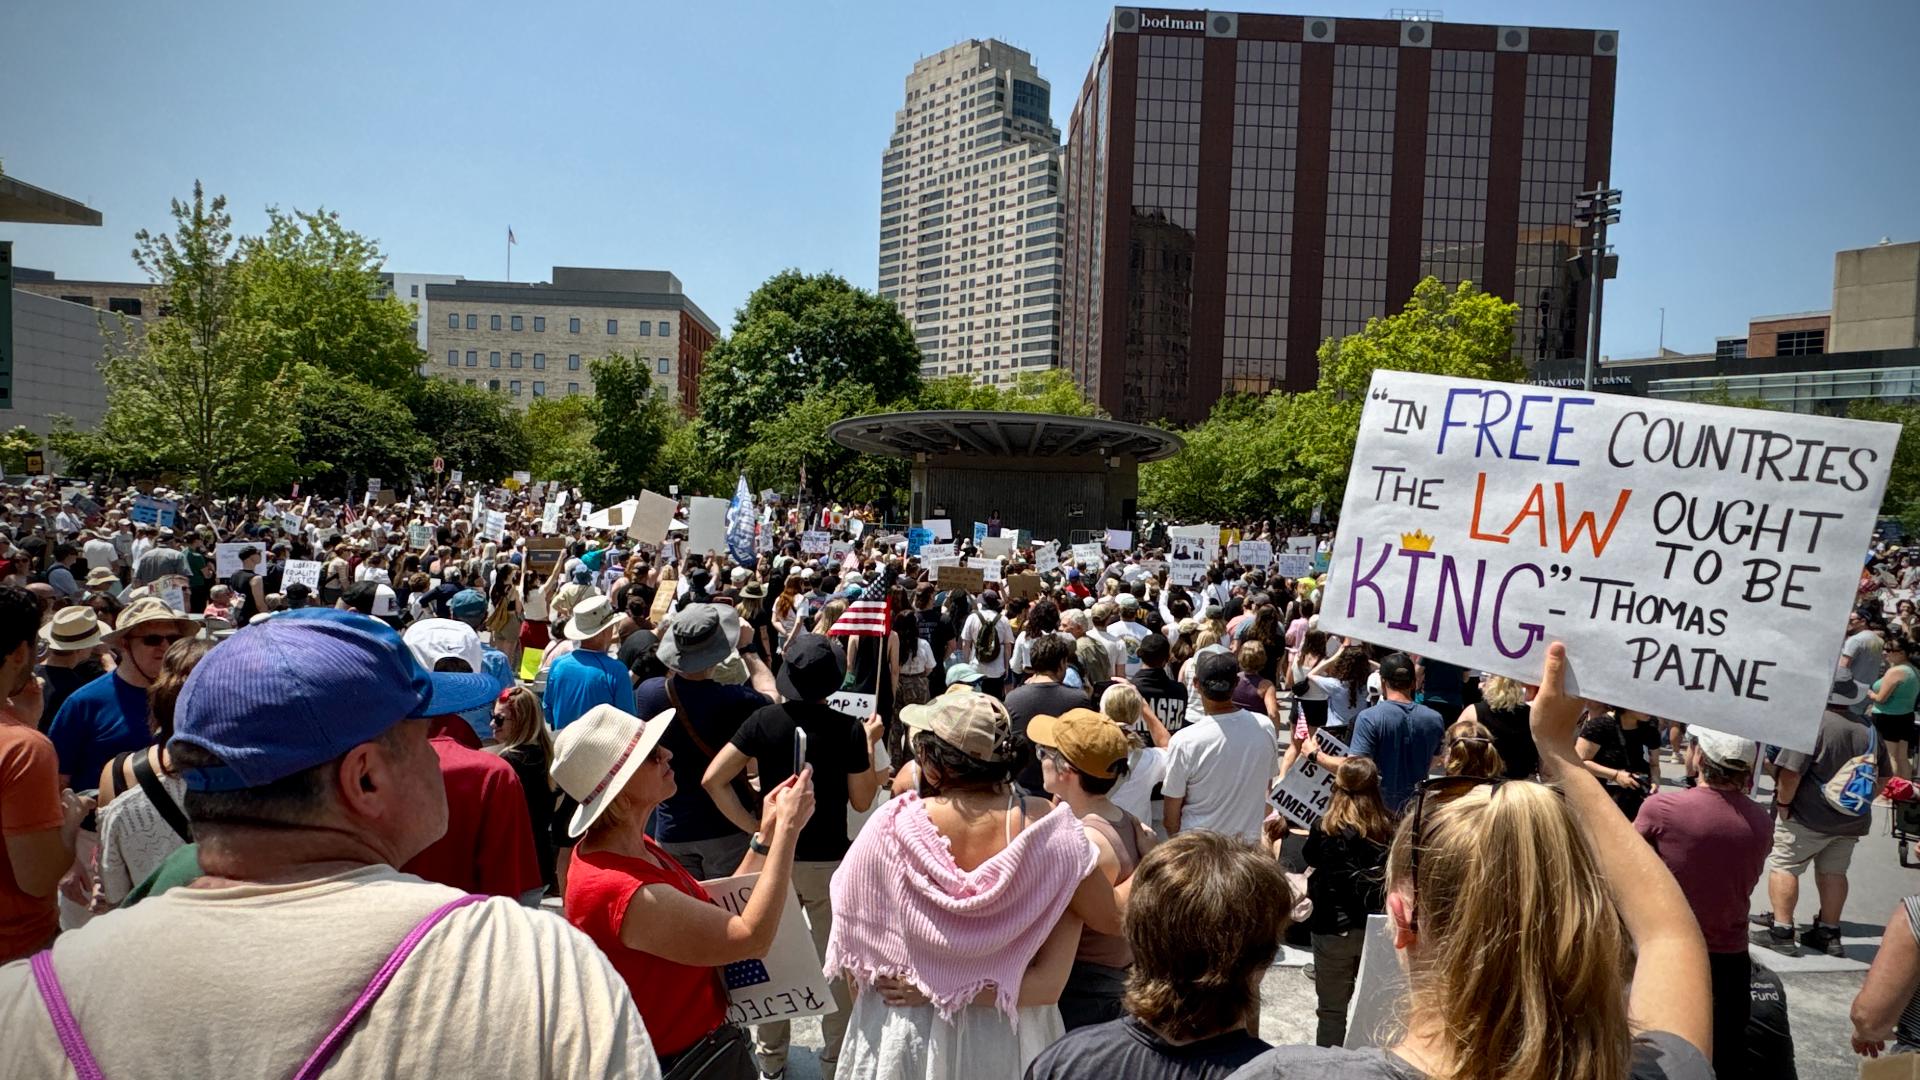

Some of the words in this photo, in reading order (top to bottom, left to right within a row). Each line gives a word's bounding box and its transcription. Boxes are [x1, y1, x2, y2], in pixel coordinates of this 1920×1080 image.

[1141, 13, 1205, 31] bodman
[1548, 377, 1600, 387] NATIONL
[1602, 375, 1632, 385] BANK
[1437, 388, 1595, 466] FREE
[1608, 411, 1878, 491] COUNTRIES
[1372, 465, 1444, 510] THE
[1470, 472, 1632, 558] LAW
[1653, 491, 1844, 553] OUGHT
[286, 569, 317, 577] EQUALITY
[288, 577, 316, 585] JUSTICE
[1655, 541, 1722, 585] TO
[1742, 559, 1821, 611] BE
[1580, 576, 1728, 636] THOMAS
[1626, 637, 1776, 701] PAINE
[856, 698, 868, 708] is
[1300, 760, 1318, 778] IS
[1272, 788, 1320, 825] AMEN
[1310, 790, 1330, 811] 14
[1750, 990, 1780, 1001] Fund
